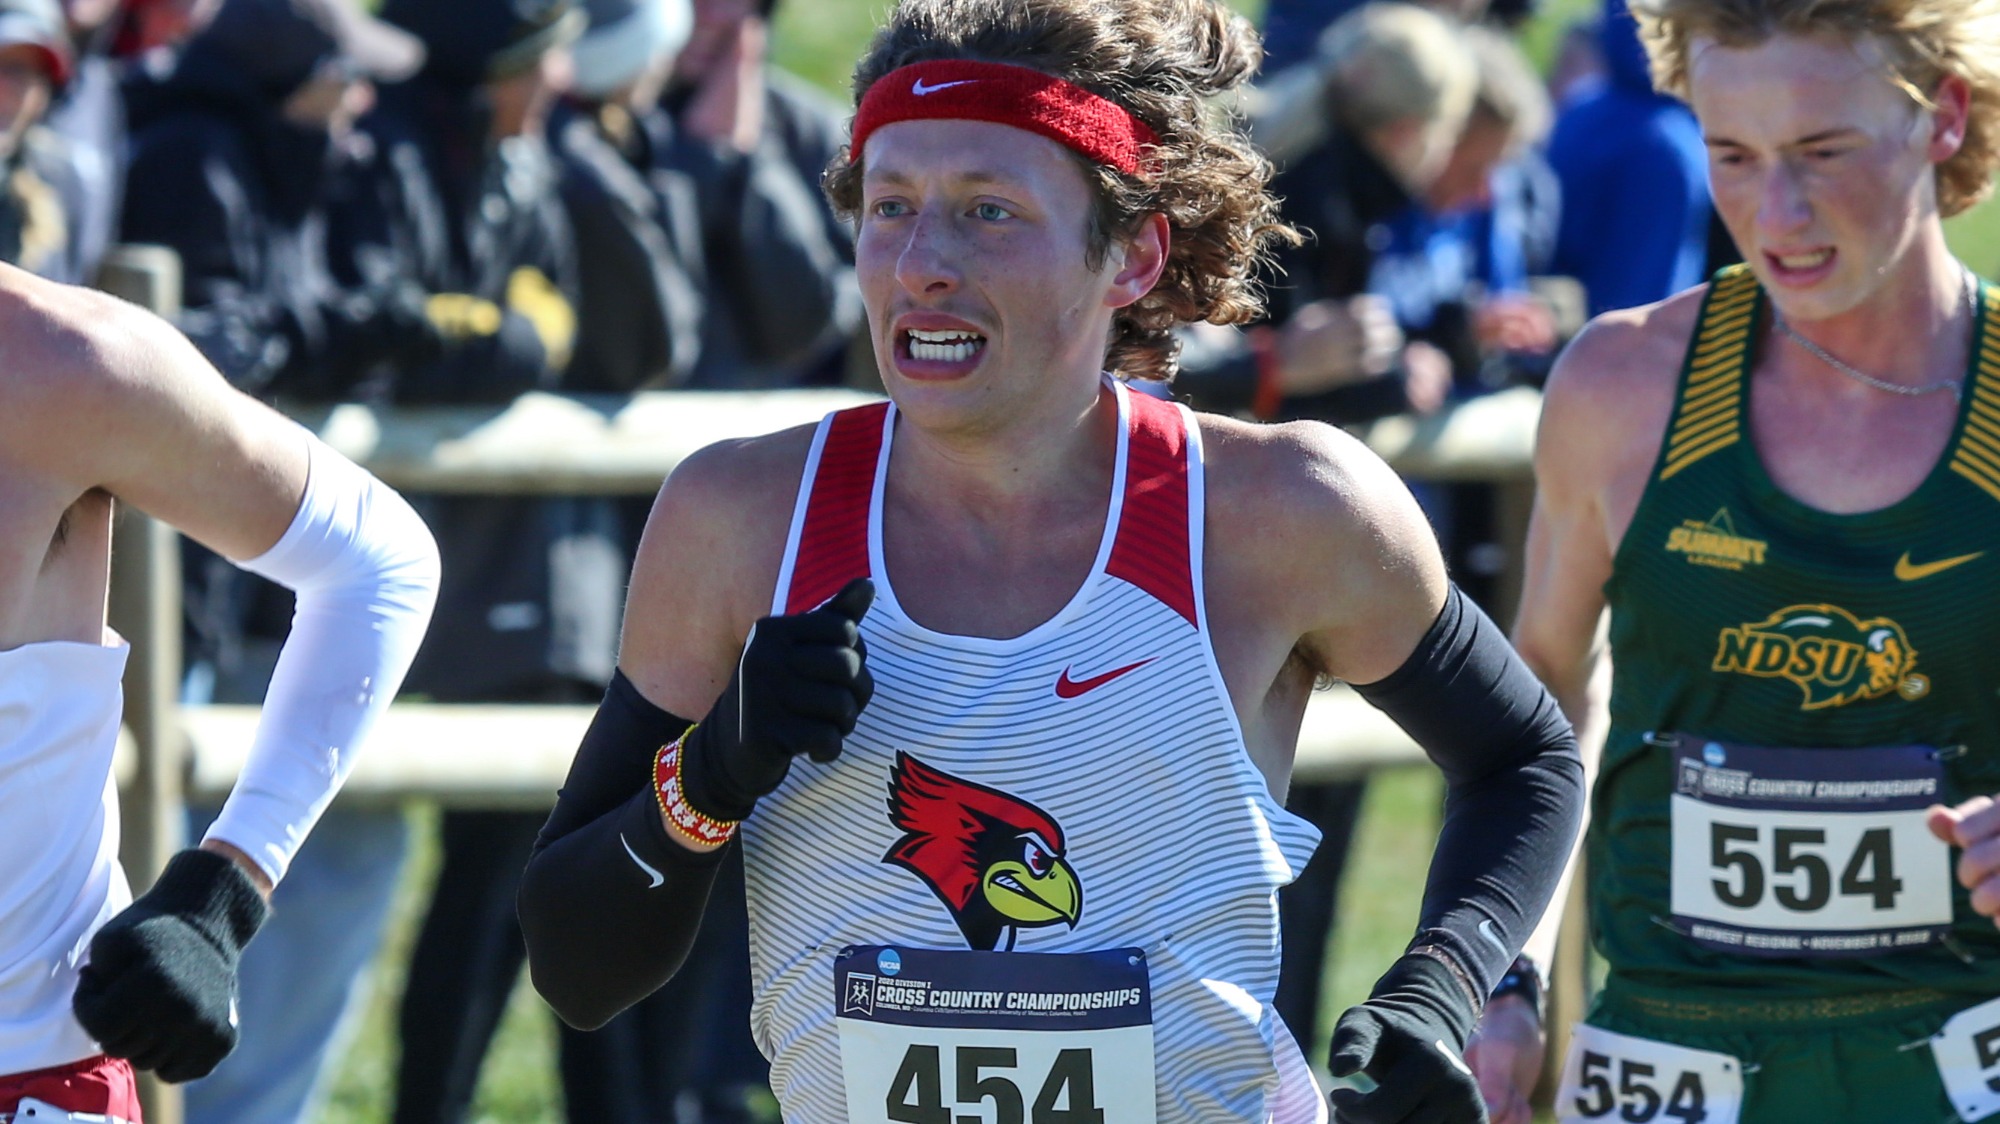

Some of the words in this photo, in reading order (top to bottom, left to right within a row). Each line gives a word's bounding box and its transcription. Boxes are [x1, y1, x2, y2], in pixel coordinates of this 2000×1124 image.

[1665, 527, 1768, 565] SUMMIT
[1712, 627, 1866, 687] NDSU
[1702, 772, 1746, 794] CROSS
[1748, 778, 1815, 796] COUNTRY
[1816, 777, 1937, 797] CHAMPIONSHIPS
[1709, 821, 1903, 914] 554
[876, 985, 926, 1006] CROSS
[929, 989, 1004, 1010] COUNTRY
[1005, 987, 1141, 1011] CHAMPIONSHIPS
[895, 978, 926, 989] DIVISION
[886, 1043, 1105, 1124] 454
[1574, 1050, 1707, 1124] 554
